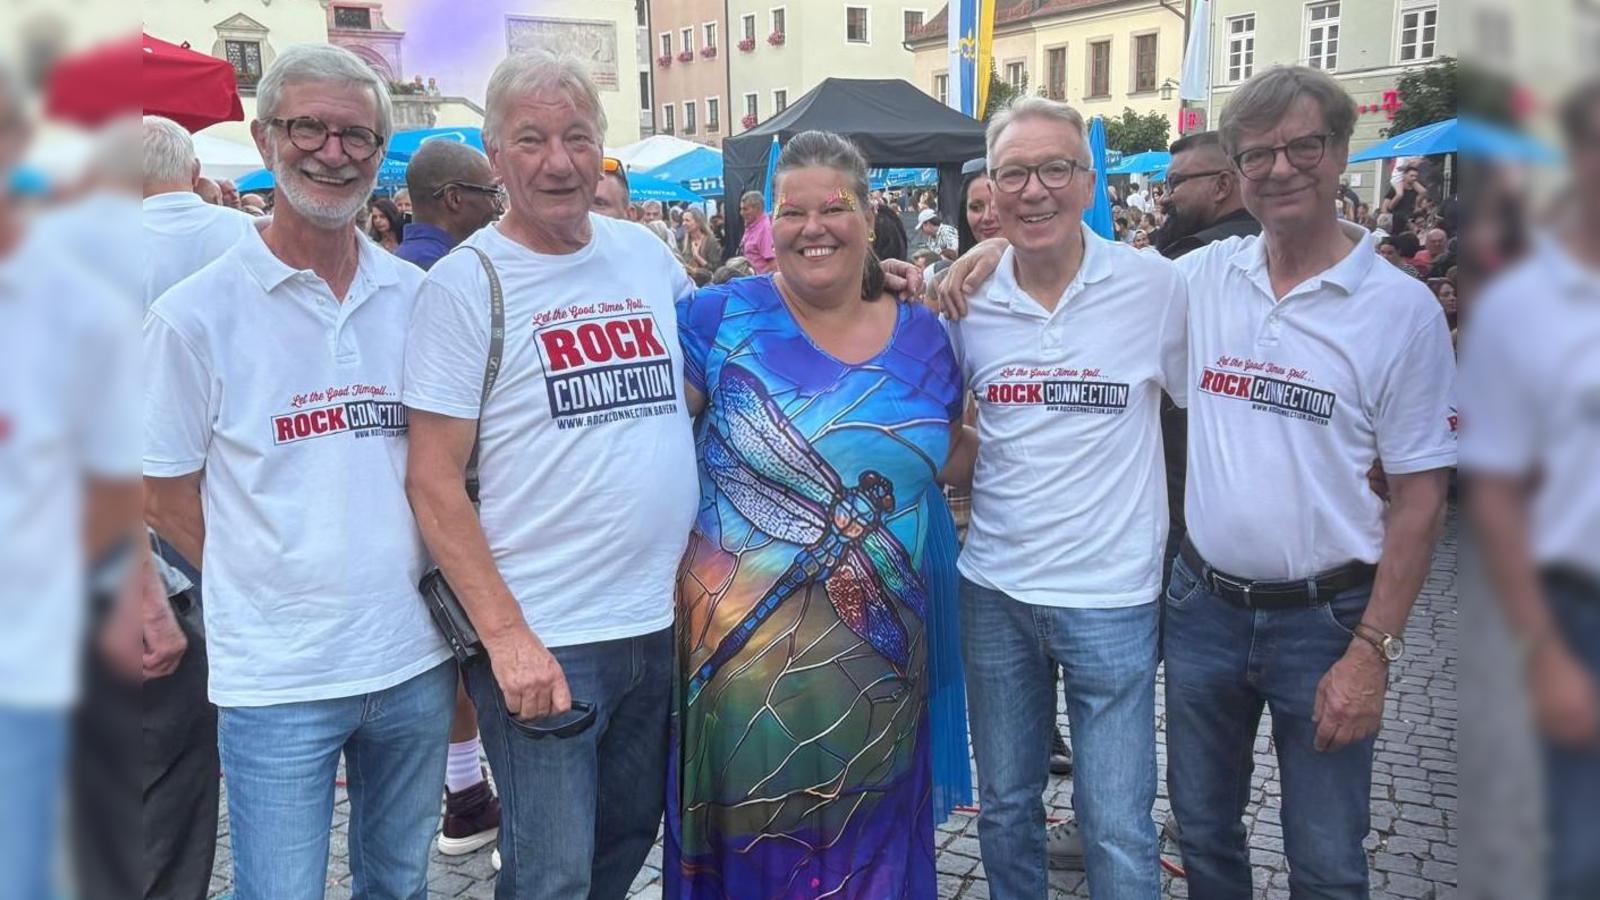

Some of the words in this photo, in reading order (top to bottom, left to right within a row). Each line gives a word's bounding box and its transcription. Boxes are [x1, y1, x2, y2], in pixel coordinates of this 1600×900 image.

[533, 313, 551, 326] Let
[552, 308, 567, 320] the
[569, 304, 595, 318] Good
[599, 302, 624, 313] Times
[540, 318, 665, 371] ROCK
[290, 394, 307, 408] Let
[310, 391, 324, 402] the
[326, 387, 349, 401] Good
[553, 364, 673, 412] CONNECTION
[987, 384, 1043, 403] ROCK
[1046, 384, 1127, 405] CONNECTION
[1200, 370, 1252, 398] ROCK
[1253, 379, 1334, 416] CONNECTION
[275, 407, 347, 441] ROCK
[557, 404, 678, 430] WWW.ROCKCONNECTION.BAYERN
